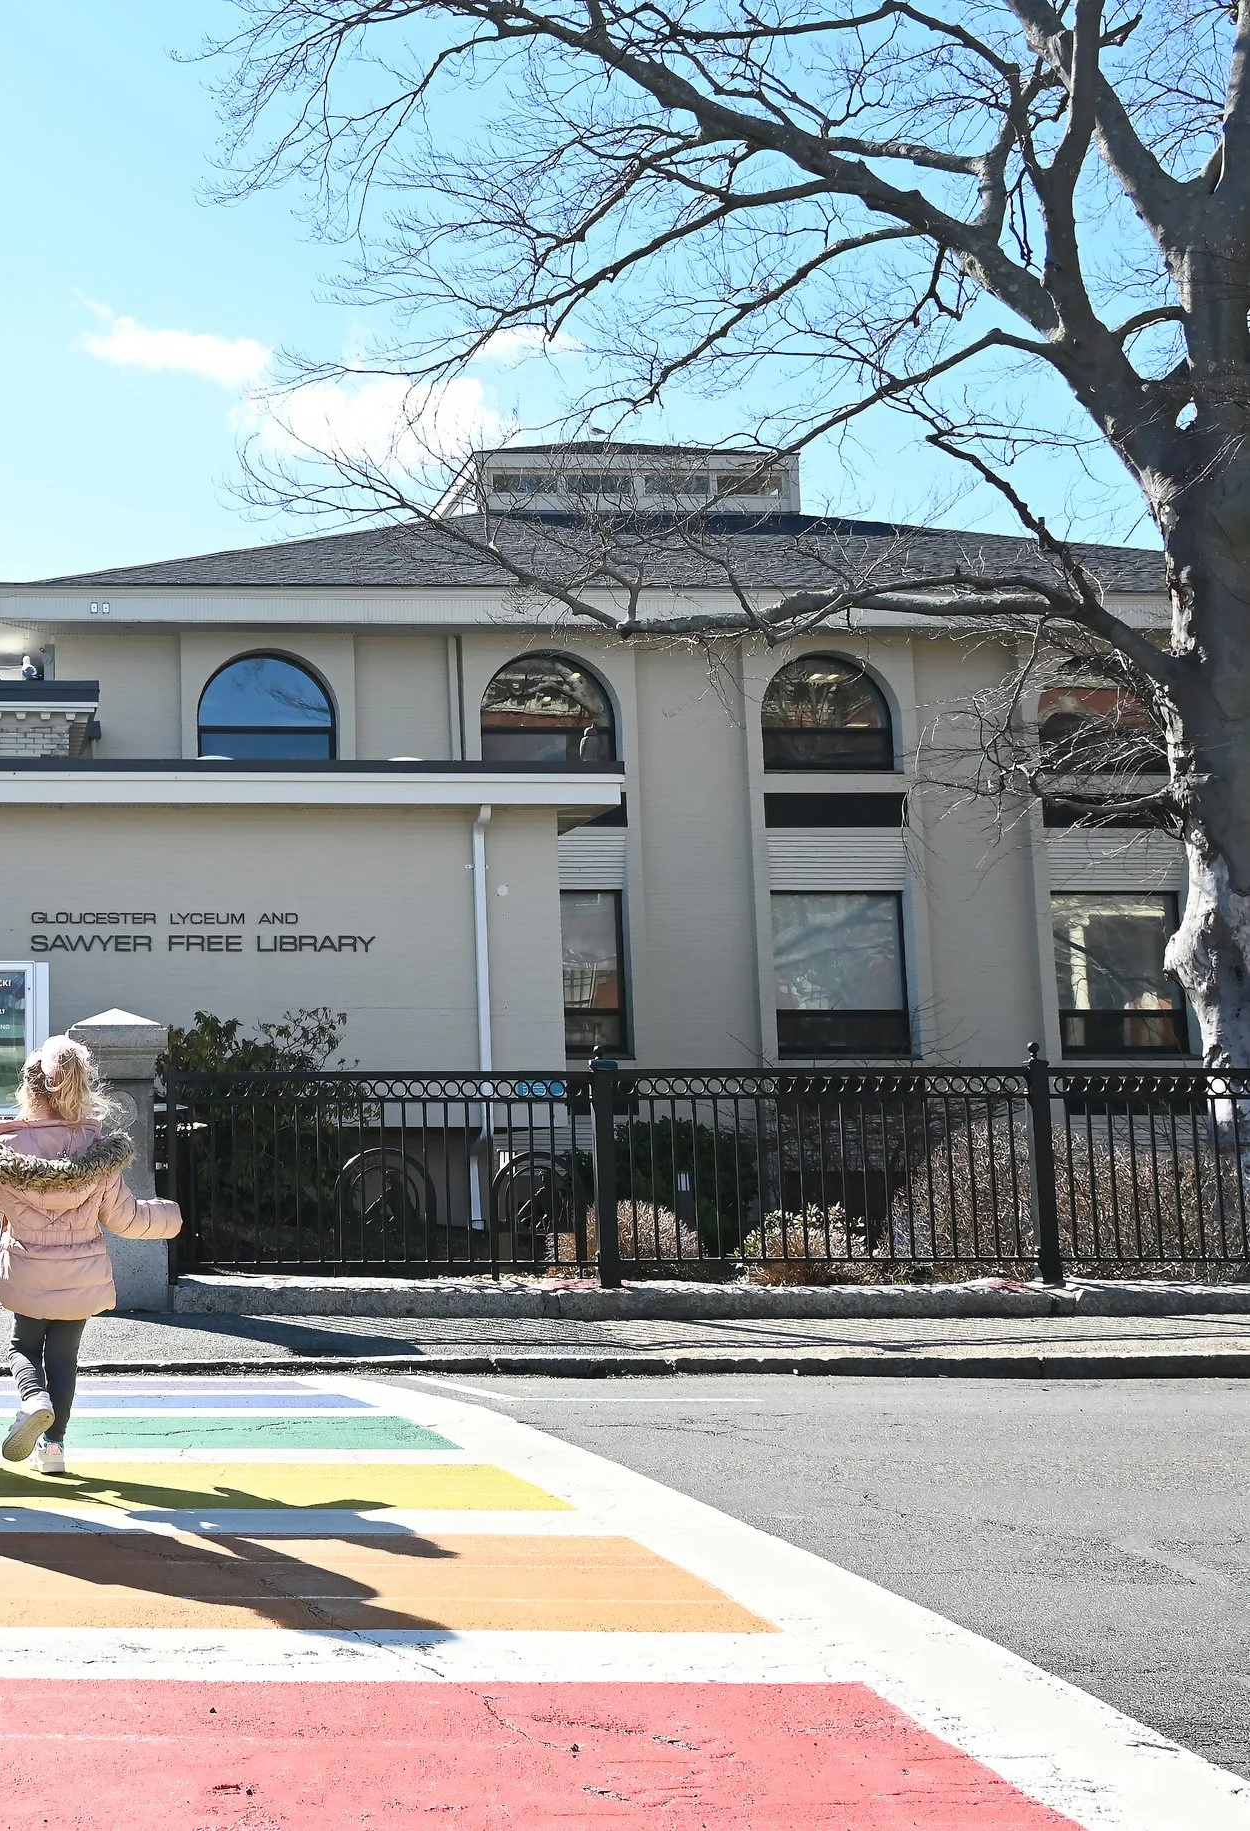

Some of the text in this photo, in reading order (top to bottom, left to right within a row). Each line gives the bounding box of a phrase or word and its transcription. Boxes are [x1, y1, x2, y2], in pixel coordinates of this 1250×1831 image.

[31, 911, 299, 925] GLOUCESTER LYCEUM AND
[30, 934, 376, 952] SAWYER FREE LIBRARY
